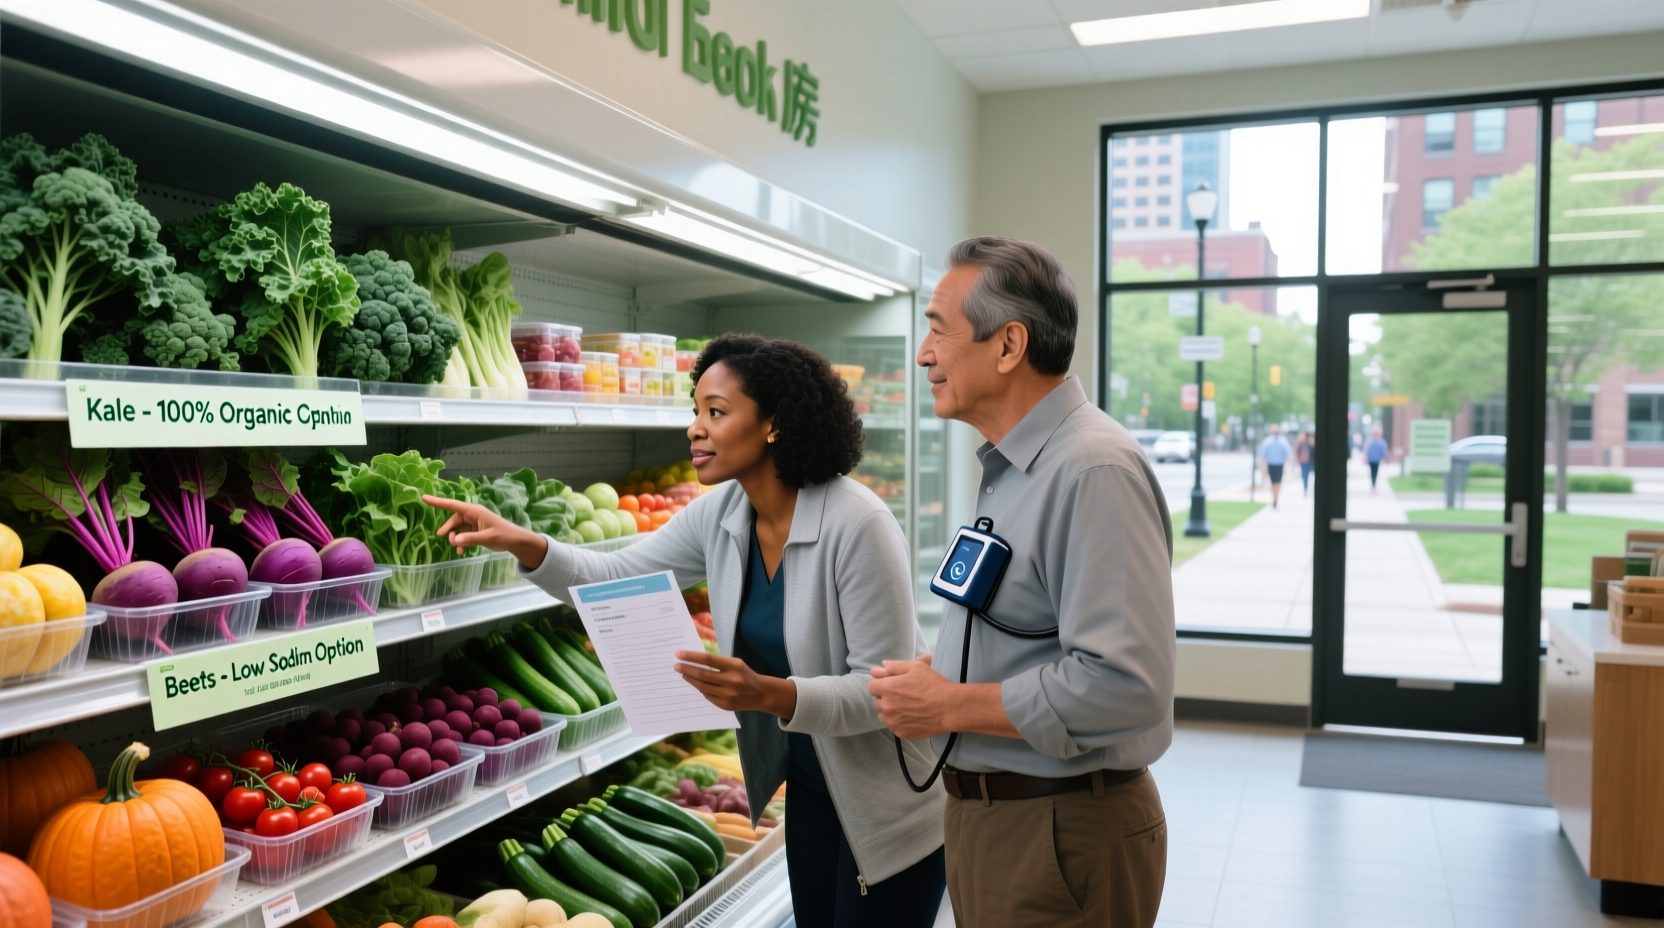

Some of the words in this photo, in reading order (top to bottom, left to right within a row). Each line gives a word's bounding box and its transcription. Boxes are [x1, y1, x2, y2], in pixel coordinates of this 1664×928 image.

[86, 397, 136, 422] Kale
[157, 399, 214, 424] 100%
[219, 401, 293, 430] Organic
[164, 670, 217, 699] Beets
[220, 673, 228, 681] -
[231, 660, 265, 682] Low
[315, 637, 364, 665] Option
